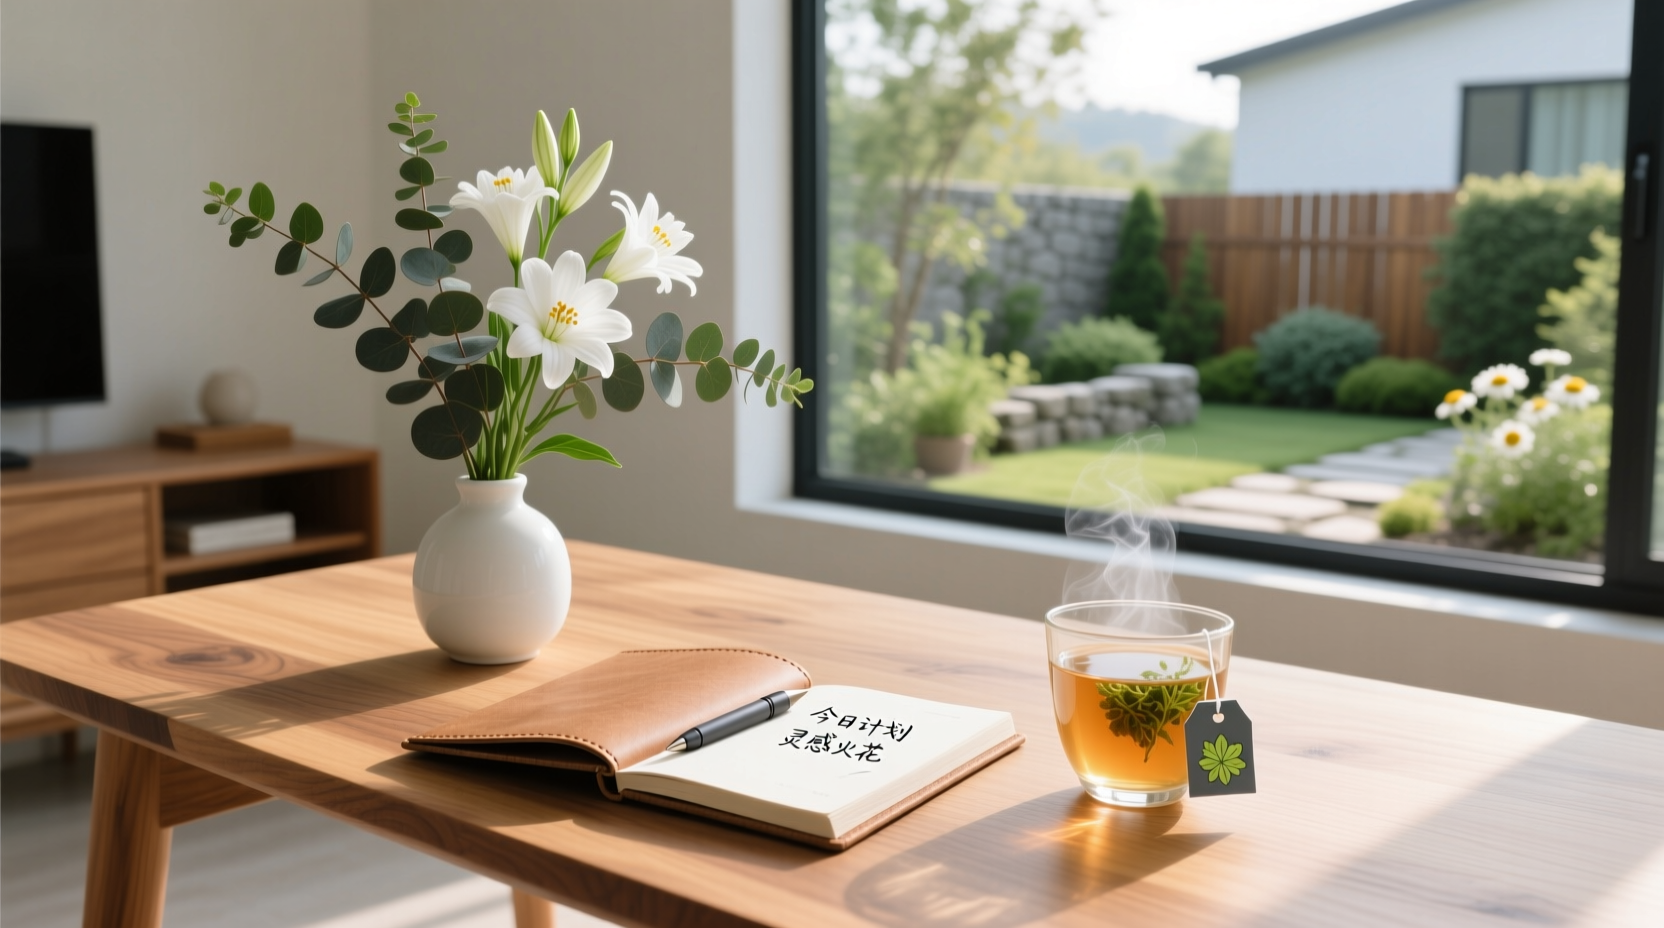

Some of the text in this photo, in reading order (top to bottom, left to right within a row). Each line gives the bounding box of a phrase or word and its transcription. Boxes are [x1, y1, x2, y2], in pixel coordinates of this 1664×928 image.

[810, 706, 913, 743] 今日计划
[778, 728, 884, 763] 灵感火花
